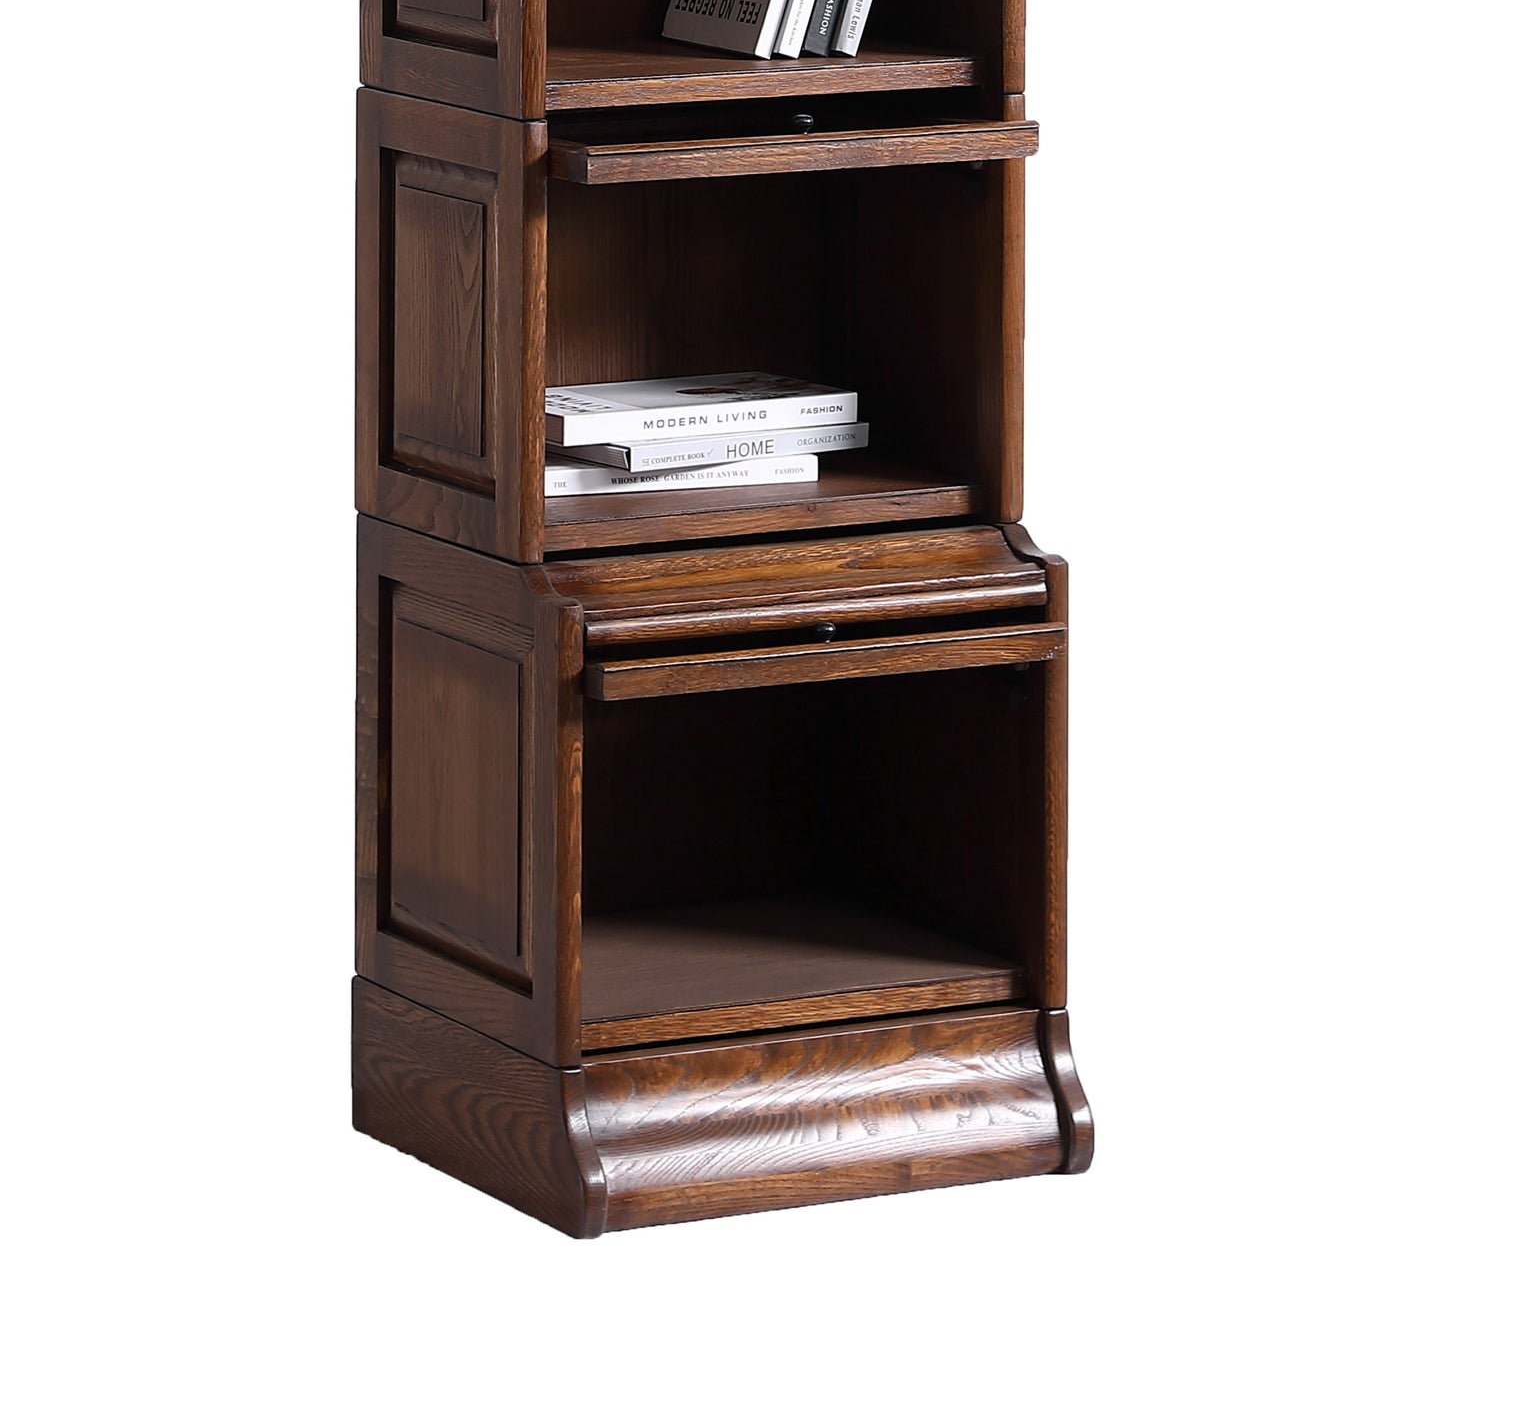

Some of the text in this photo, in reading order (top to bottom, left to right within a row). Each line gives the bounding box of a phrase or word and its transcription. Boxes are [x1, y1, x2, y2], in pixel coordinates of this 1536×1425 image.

[736, 0, 763, 25] FEEL
[847, 14, 861, 40] Lewis
[800, 404, 844, 415] FASHION
[643, 410, 768, 430] MODERN LIVING
[650, 454, 687, 465] COMPLETE
[687, 451, 706, 461] BOOK
[726, 439, 775, 459] HOME
[797, 432, 857, 447] ORGANIZATION
[610, 469, 750, 485] WHOSE ROSE GARDEN IS IT ANYWAY
[774, 466, 805, 476] FASHION
[553, 481, 568, 489] THE
